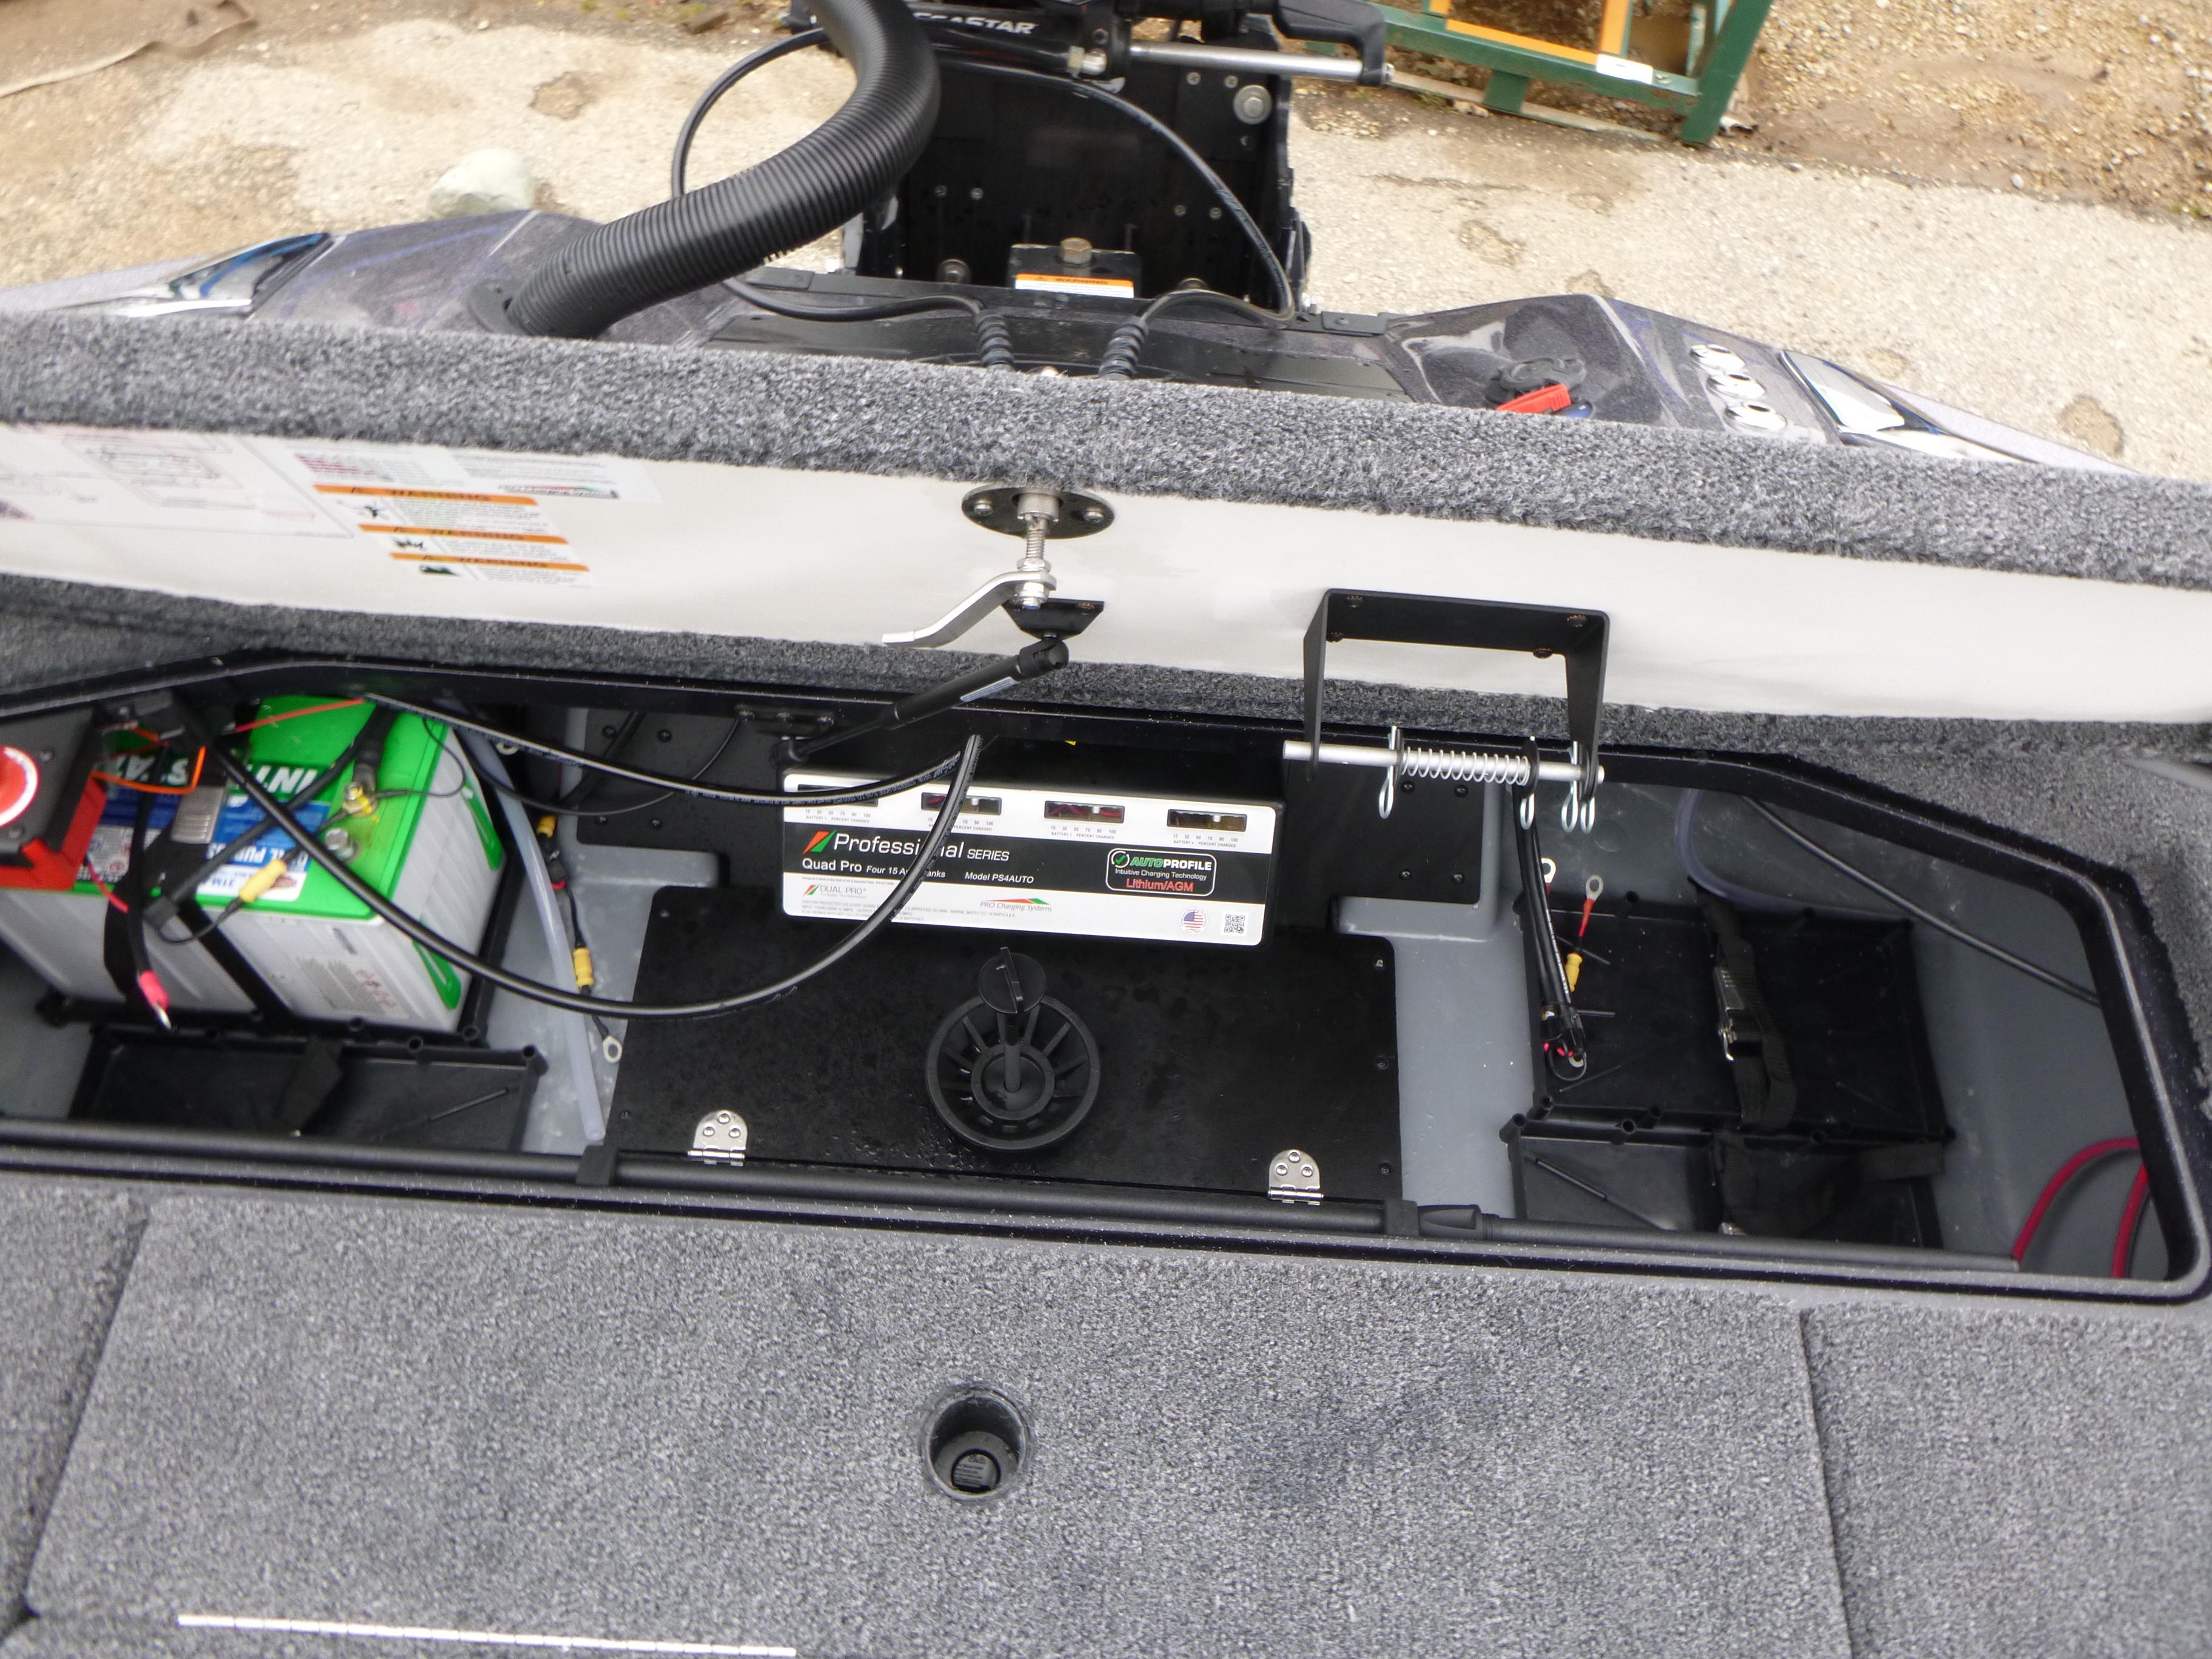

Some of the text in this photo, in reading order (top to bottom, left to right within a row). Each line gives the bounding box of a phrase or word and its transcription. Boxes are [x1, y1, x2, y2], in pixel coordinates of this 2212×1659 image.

[834, 833, 1010, 862] Professial SERIES
[802, 857, 836, 871] Quad
[840, 860, 862, 873] Pro
[866, 865, 886, 874] Four
[888, 866, 898, 876] 15
[926, 870, 946, 878] anks
[965, 871, 990, 881] Model
[991, 873, 1034, 884] PS4AUTO
[1130, 856, 1212, 871] AUTOPROFILE
[1115, 868, 1207, 881] Intuitive Charging Technology
[820, 885, 843, 893] DUAL
[1126, 878, 1195, 893] Lithium/AGM
[996, 902, 1026, 911] Charging
